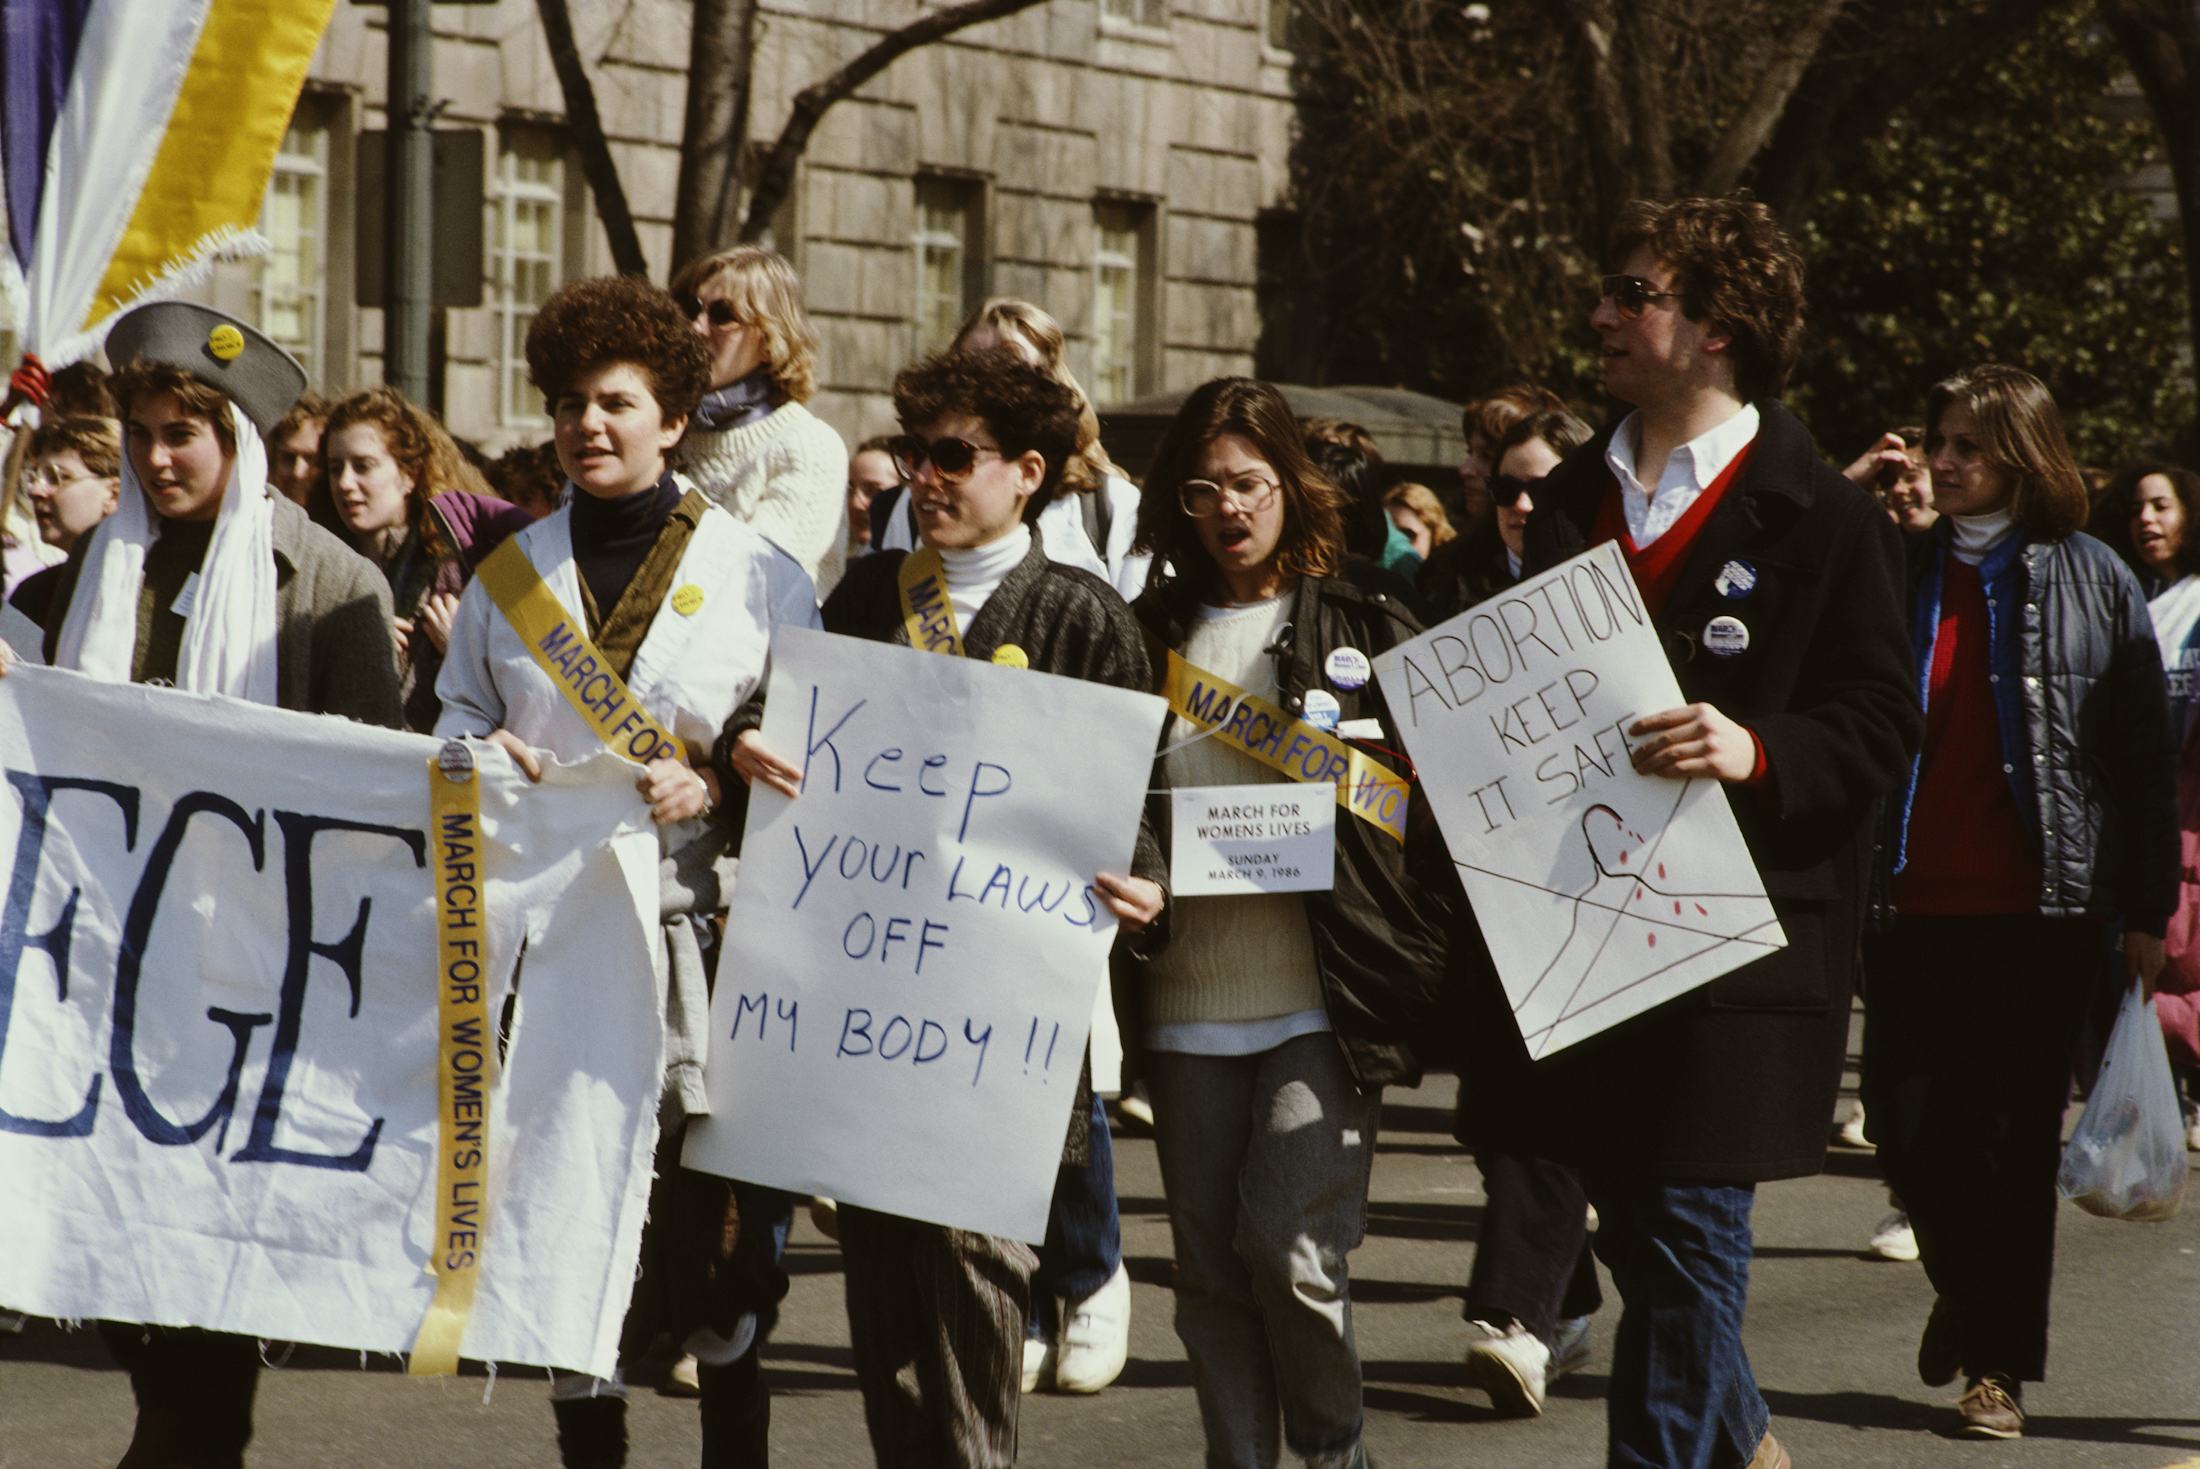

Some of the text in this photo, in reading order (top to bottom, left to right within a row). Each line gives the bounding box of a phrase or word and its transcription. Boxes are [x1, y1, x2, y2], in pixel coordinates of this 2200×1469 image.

[1400, 549, 1644, 727] ABORTION
[538, 621, 676, 766] MARCH FOR
[1185, 681, 1286, 758] MARCH
[1282, 735, 1350, 783] FOR
[1489, 669, 1599, 756] KEEP
[800, 685, 1013, 843] Keep
[1467, 712, 1636, 835] IT SAFE
[1196, 821, 1312, 840] WOMENS LIVES
[1207, 803, 1301, 821] MARCH FOR
[442, 813, 477, 929] MARCH
[948, 856, 1099, 926] LAWS
[1208, 868, 1251, 881] MARCH
[1272, 866, 1302, 879] 1986
[1227, 853, 1280, 866] SUNDAY
[448, 940, 481, 1005] FOR
[842, 912, 949, 974] OFF
[731, 991, 1060, 1087] MY BODY !!
[451, 1017, 484, 1169] WOMEN'S
[445, 1183, 481, 1272] LIVES
